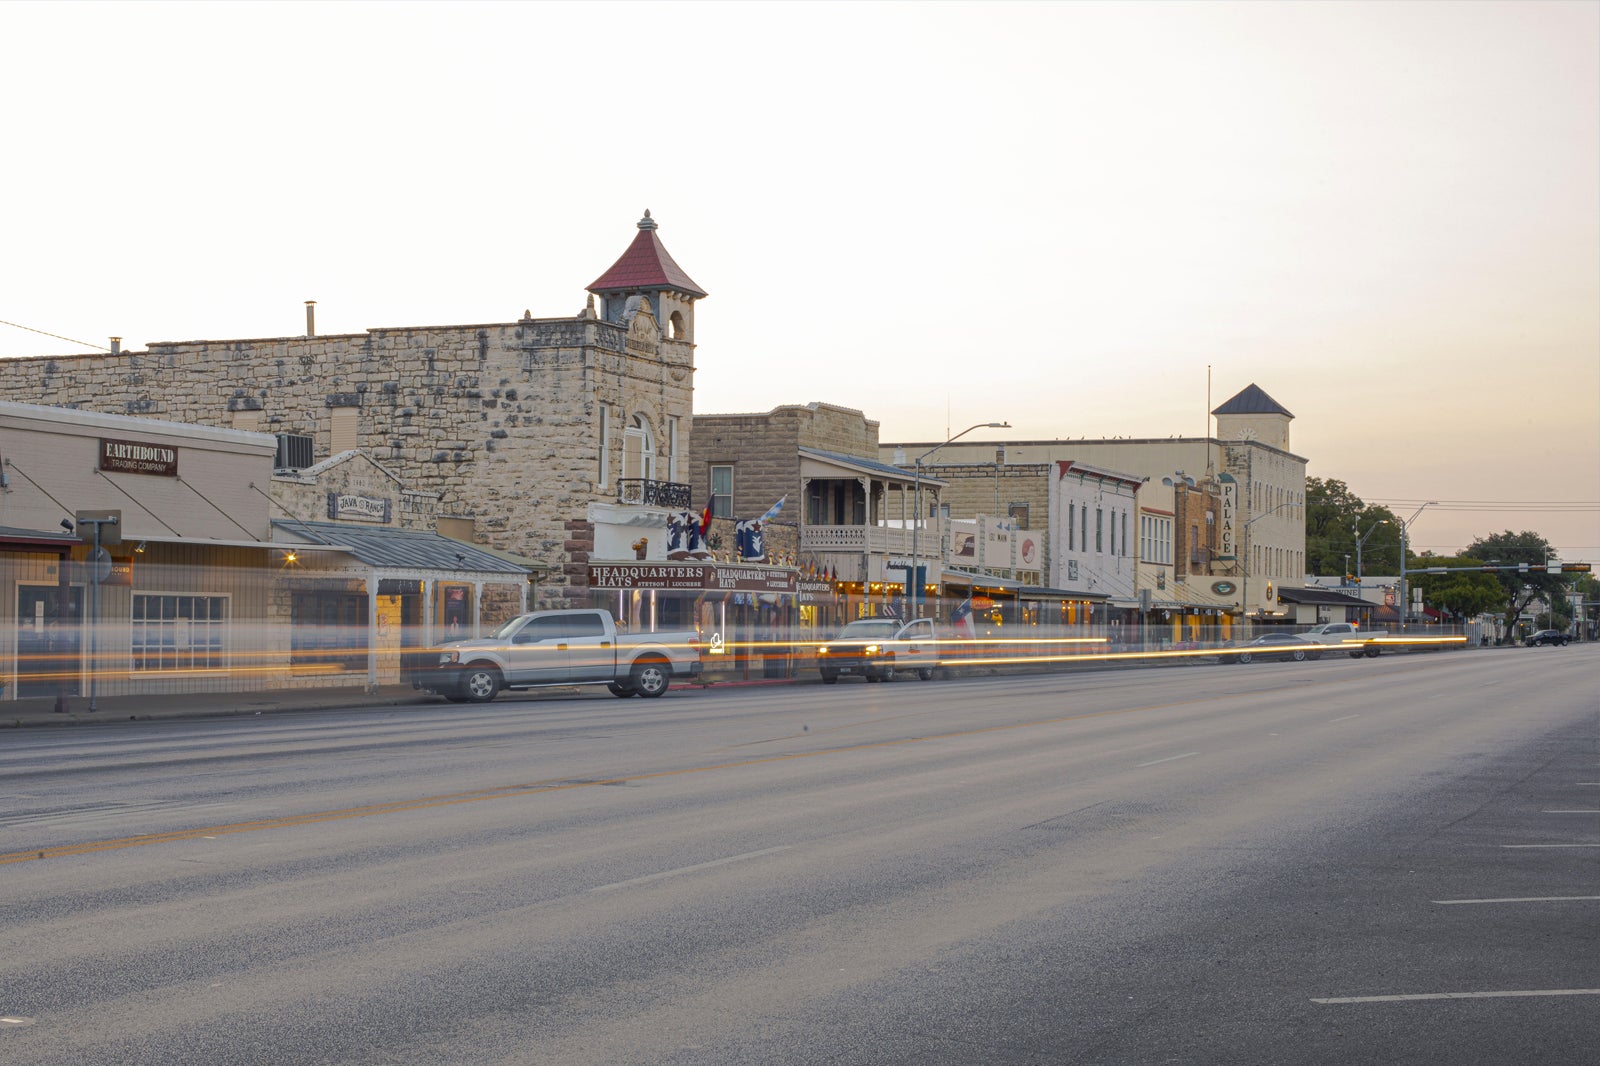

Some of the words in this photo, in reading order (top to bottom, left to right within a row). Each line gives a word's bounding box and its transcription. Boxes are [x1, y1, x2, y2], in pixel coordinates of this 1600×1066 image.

[106, 443, 174, 463] EARTHBOUND
[112, 459, 137, 469] TRADING
[137, 462, 167, 472] COMPANY
[340, 498, 358, 509] JAVA
[365, 500, 384, 513] RANCH
[1222, 486, 1232, 553] PALACE
[592, 567, 703, 579] HEADQUARTERS
[717, 568, 766, 581] HEADQUARTERS
[597, 577, 632, 587] HATS
[719, 578, 736, 588] HATS
